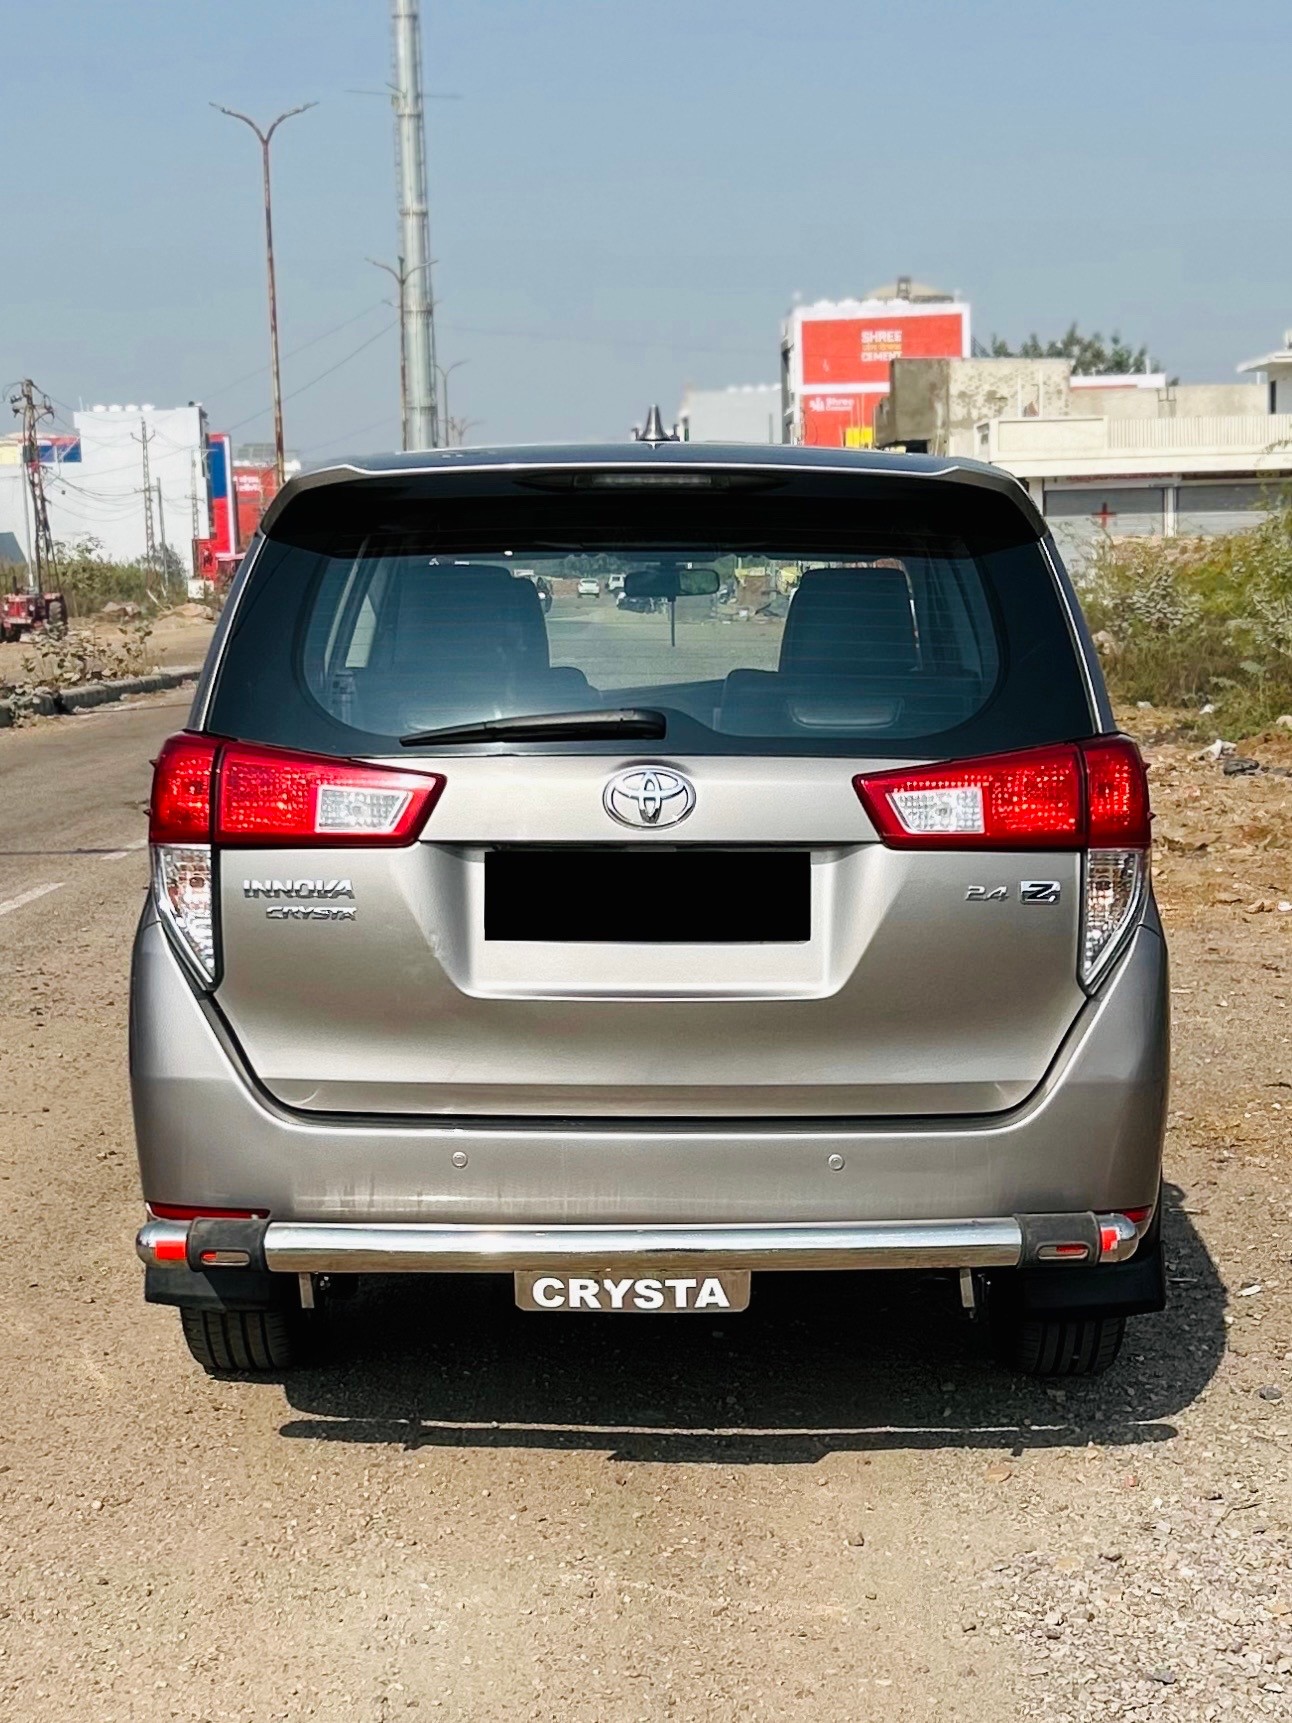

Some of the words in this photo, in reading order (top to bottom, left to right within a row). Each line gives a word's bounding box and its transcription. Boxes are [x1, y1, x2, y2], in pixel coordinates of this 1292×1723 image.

[243, 879, 355, 899] INNOVA
[265, 905, 357, 921] CRYSTA
[532, 1277, 730, 1310] CRYSTA
